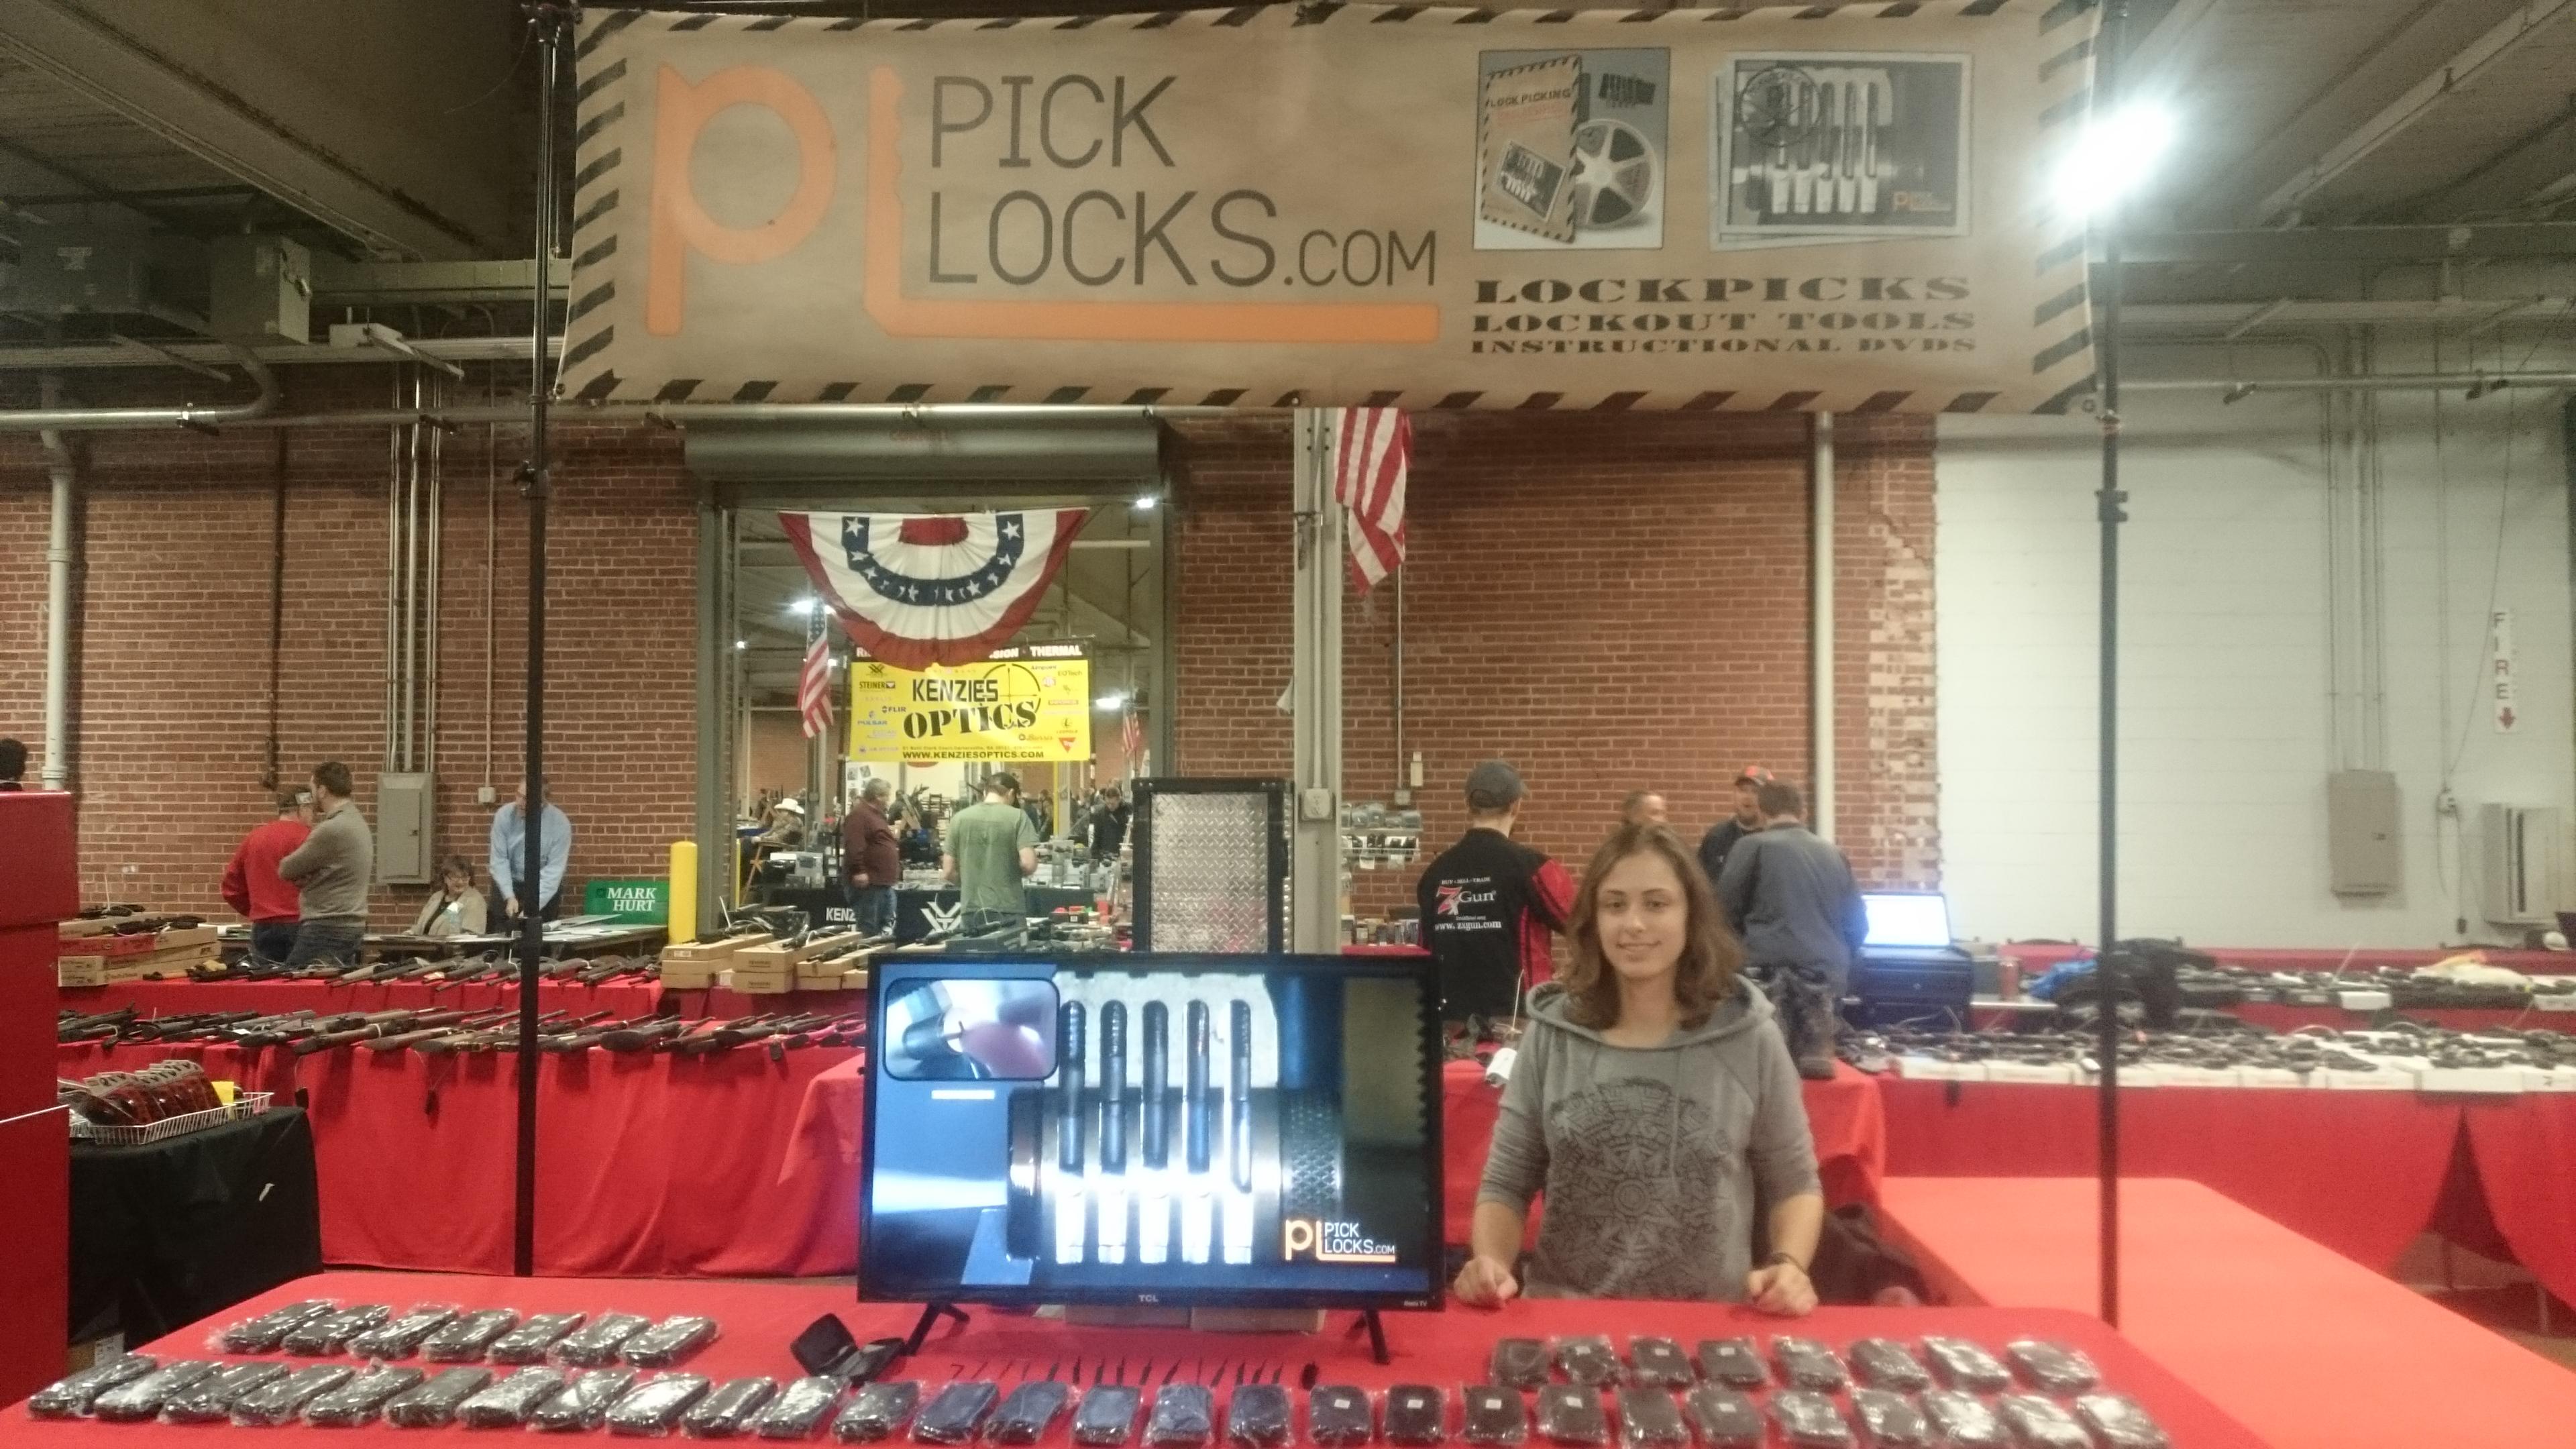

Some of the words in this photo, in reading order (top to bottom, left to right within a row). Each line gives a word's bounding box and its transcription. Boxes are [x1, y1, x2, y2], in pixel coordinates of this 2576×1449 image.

[1521, 89, 1572, 103] PICKING
[931, 74, 1179, 168] PICK
[928, 188, 1437, 287] LOCKS.COM
[1474, 276, 1972, 305] LOCKPICKS
[1472, 313, 1757, 333] LOCKOUT
[1778, 311, 1976, 331] TOOLS
[1471, 338, 1842, 355] INSTRUCTIONAL
[1858, 337, 1976, 354] DVDS
[1030, 645, 1083, 657] THERMAL
[2493, 611, 2510, 700] FIRE
[859, 680, 886, 690] STEINER
[912, 678, 999, 702] KENZIES
[903, 700, 1036, 739] OPTICS
[902, 751, 1044, 759] WWW.KENZIESOPTICS.COM
[606, 887, 657, 899] MARK
[612, 899, 655, 912] HURT
[825, 906, 857, 922] KENZ
[1324, 1222, 1360, 1238] PICK
[1324, 1239, 1395, 1254] LOCKS.COM
[1138, 1294, 1159, 1302] TCL
